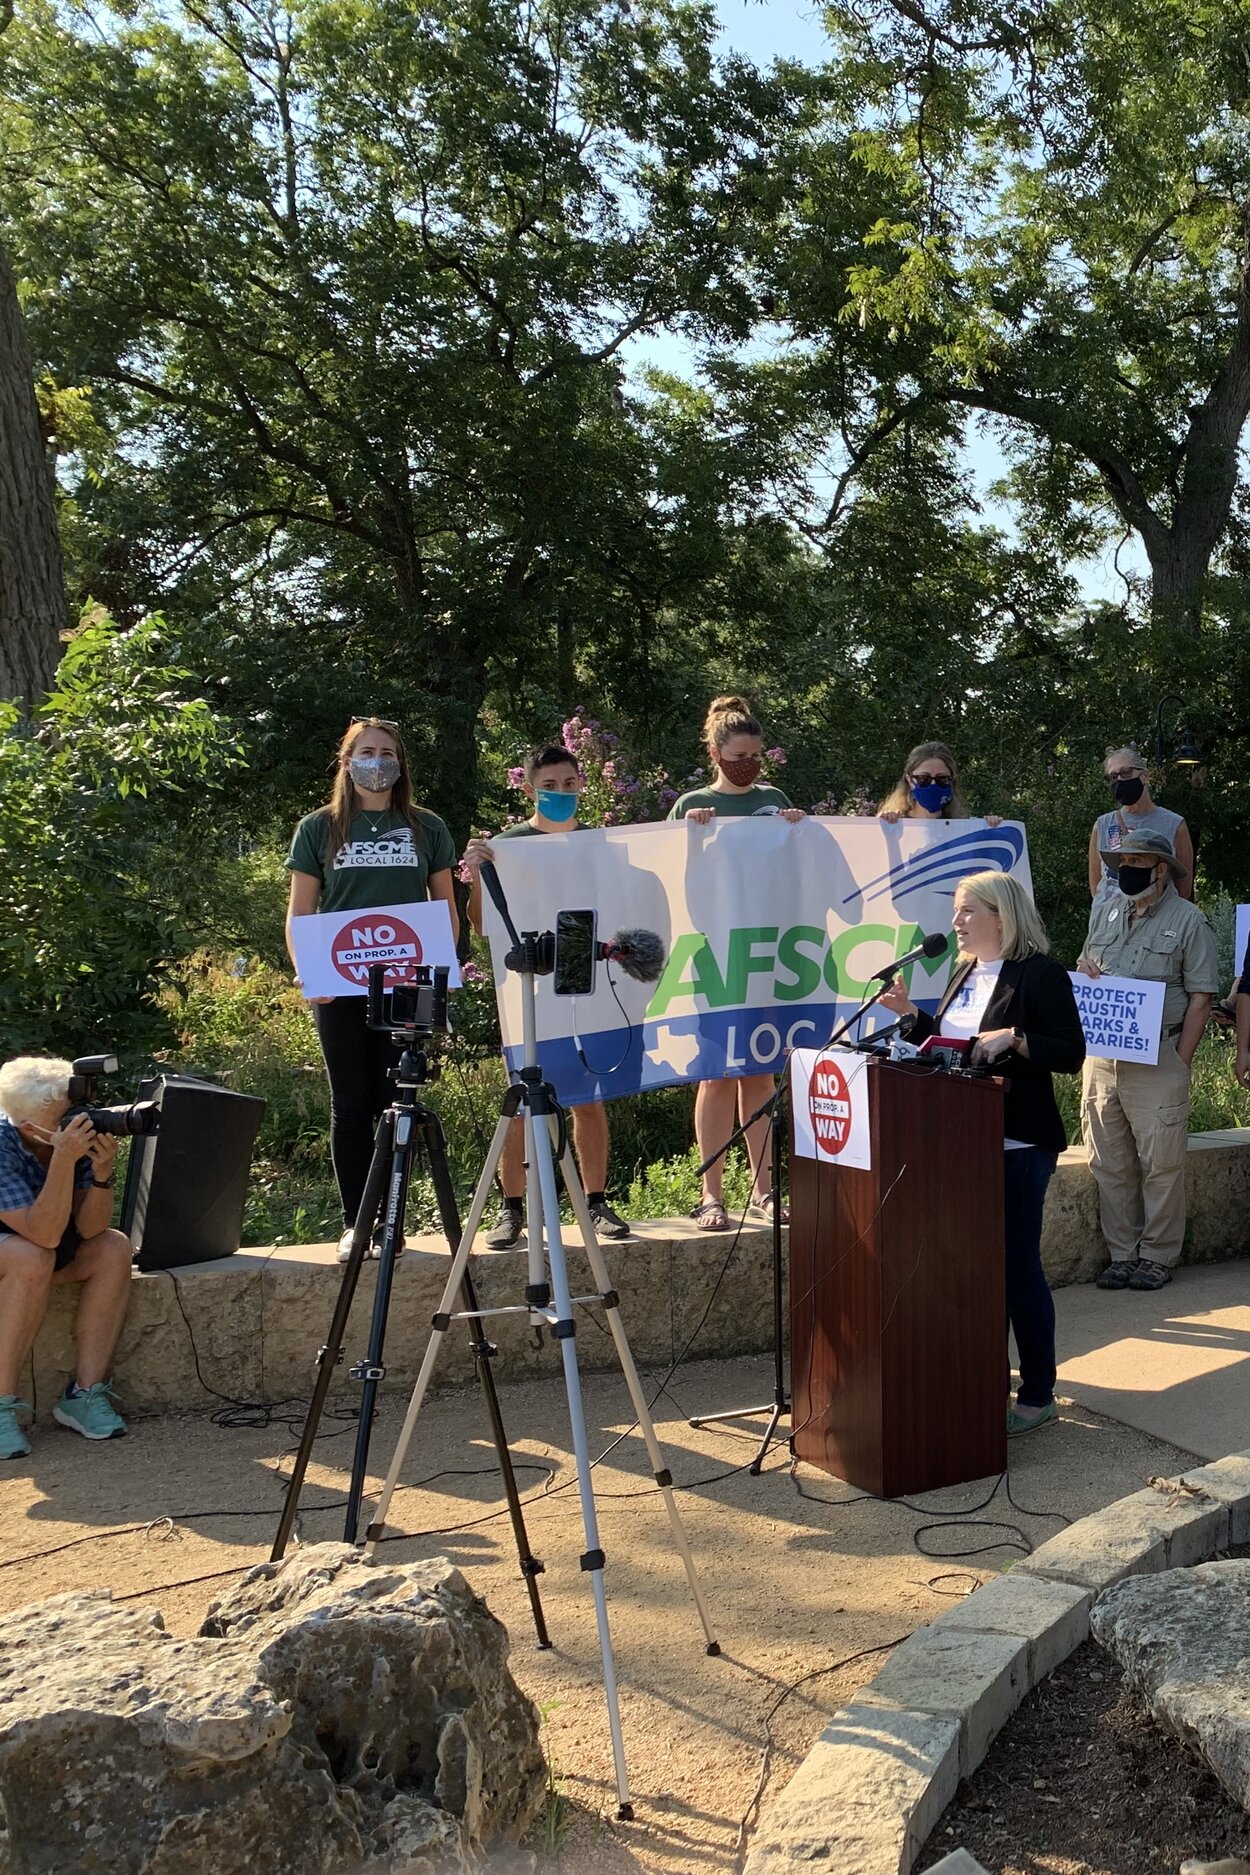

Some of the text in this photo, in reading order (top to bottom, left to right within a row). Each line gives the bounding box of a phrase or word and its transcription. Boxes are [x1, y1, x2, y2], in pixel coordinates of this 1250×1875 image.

[336, 841, 417, 856] AFSCME
[350, 854, 414, 865] LOCAL 1624
[351, 924, 396, 947] NO
[344, 947, 408, 961] ON PROP. A
[644, 923, 958, 1019] AFSCM
[1072, 984, 1147, 1006] PROTECT
[1078, 1000, 1137, 1020] AUSTIN
[1081, 1016, 1140, 1035] ARKS &
[1085, 1031, 1149, 1051] RARIES!
[816, 1072, 840, 1097] NO
[822, 1102, 839, 1113] PROP.
[840, 1105, 844, 1113] A
[815, 1117, 846, 1142] WAY
[388, 1172, 403, 1224] Manfrotto
